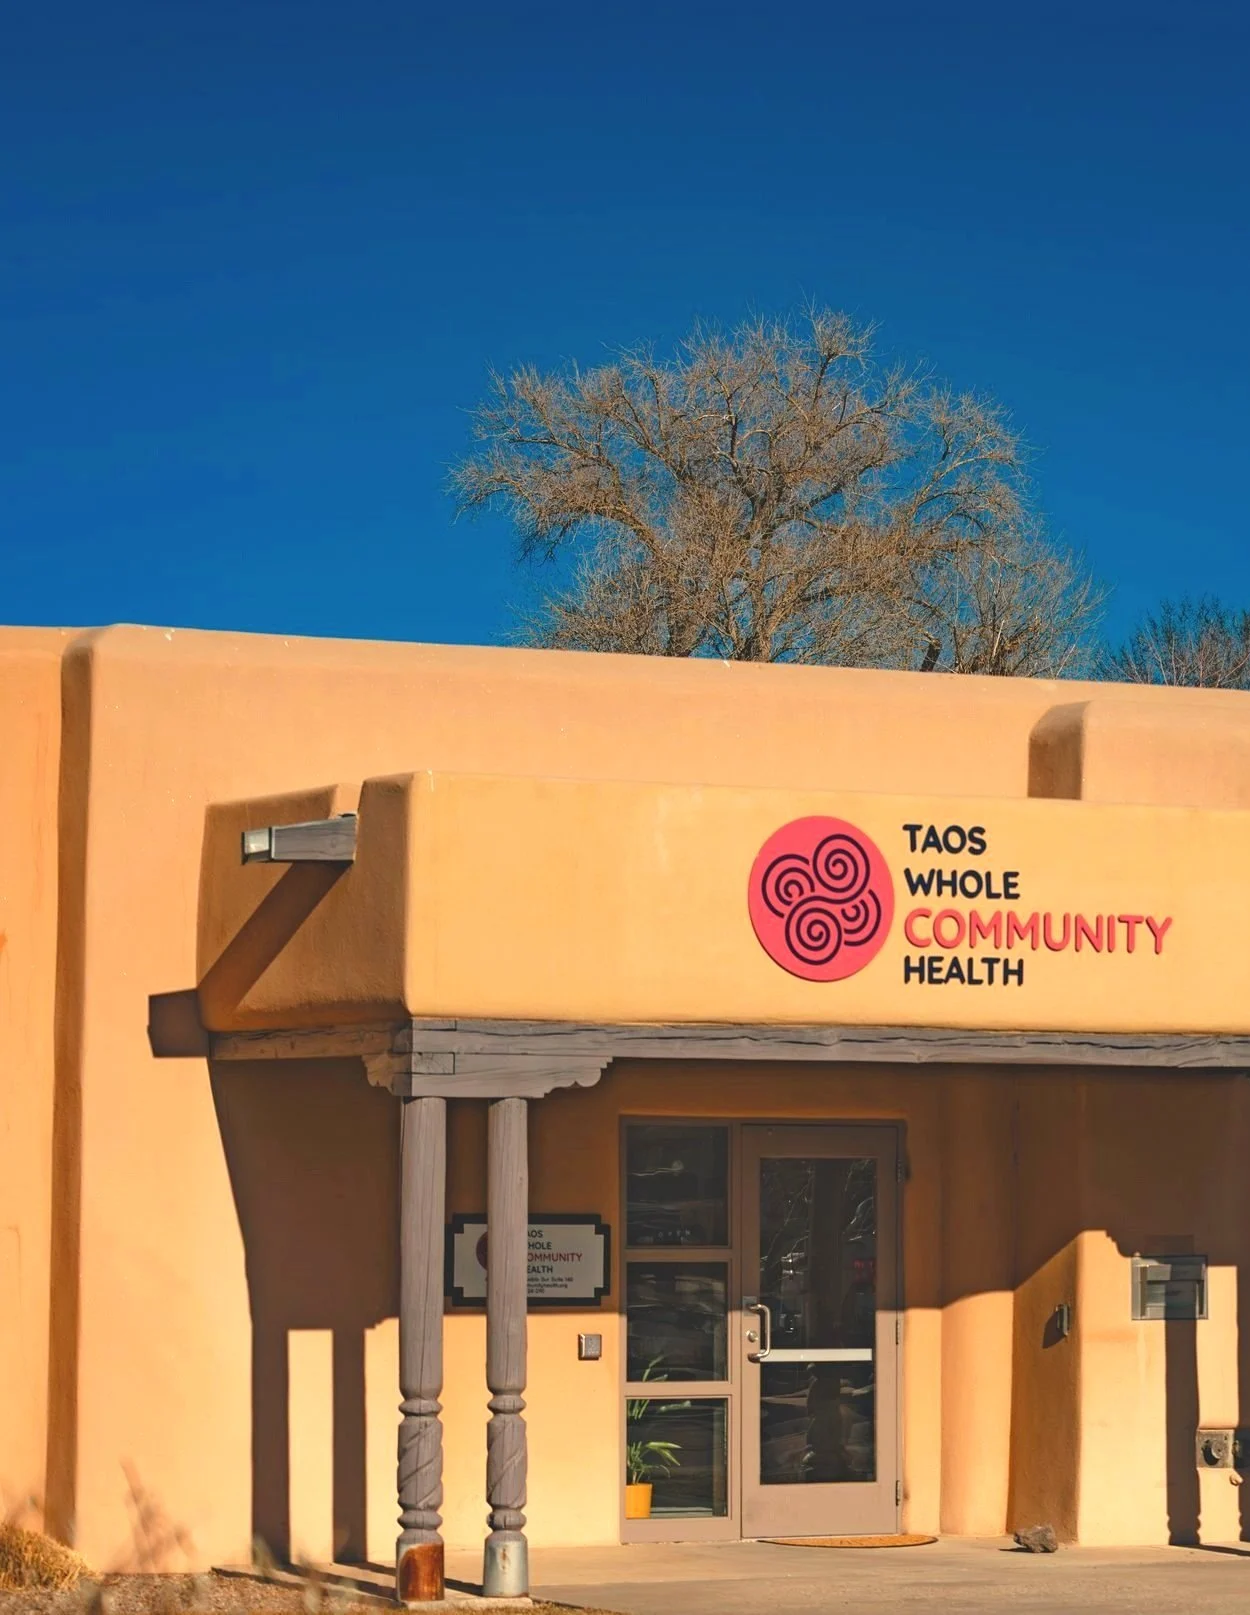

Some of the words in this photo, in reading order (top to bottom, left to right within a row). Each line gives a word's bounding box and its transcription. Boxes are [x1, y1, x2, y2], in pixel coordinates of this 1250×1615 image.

[902, 824, 988, 856] TAOS
[903, 868, 1021, 900] WHOLE
[904, 908, 1174, 955] COMMUNITY
[903, 955, 1024, 987] HEALTH
[527, 1241, 553, 1250] HOLE
[527, 1252, 583, 1263] OMMUNITY
[527, 1265, 554, 1274] EALTH
